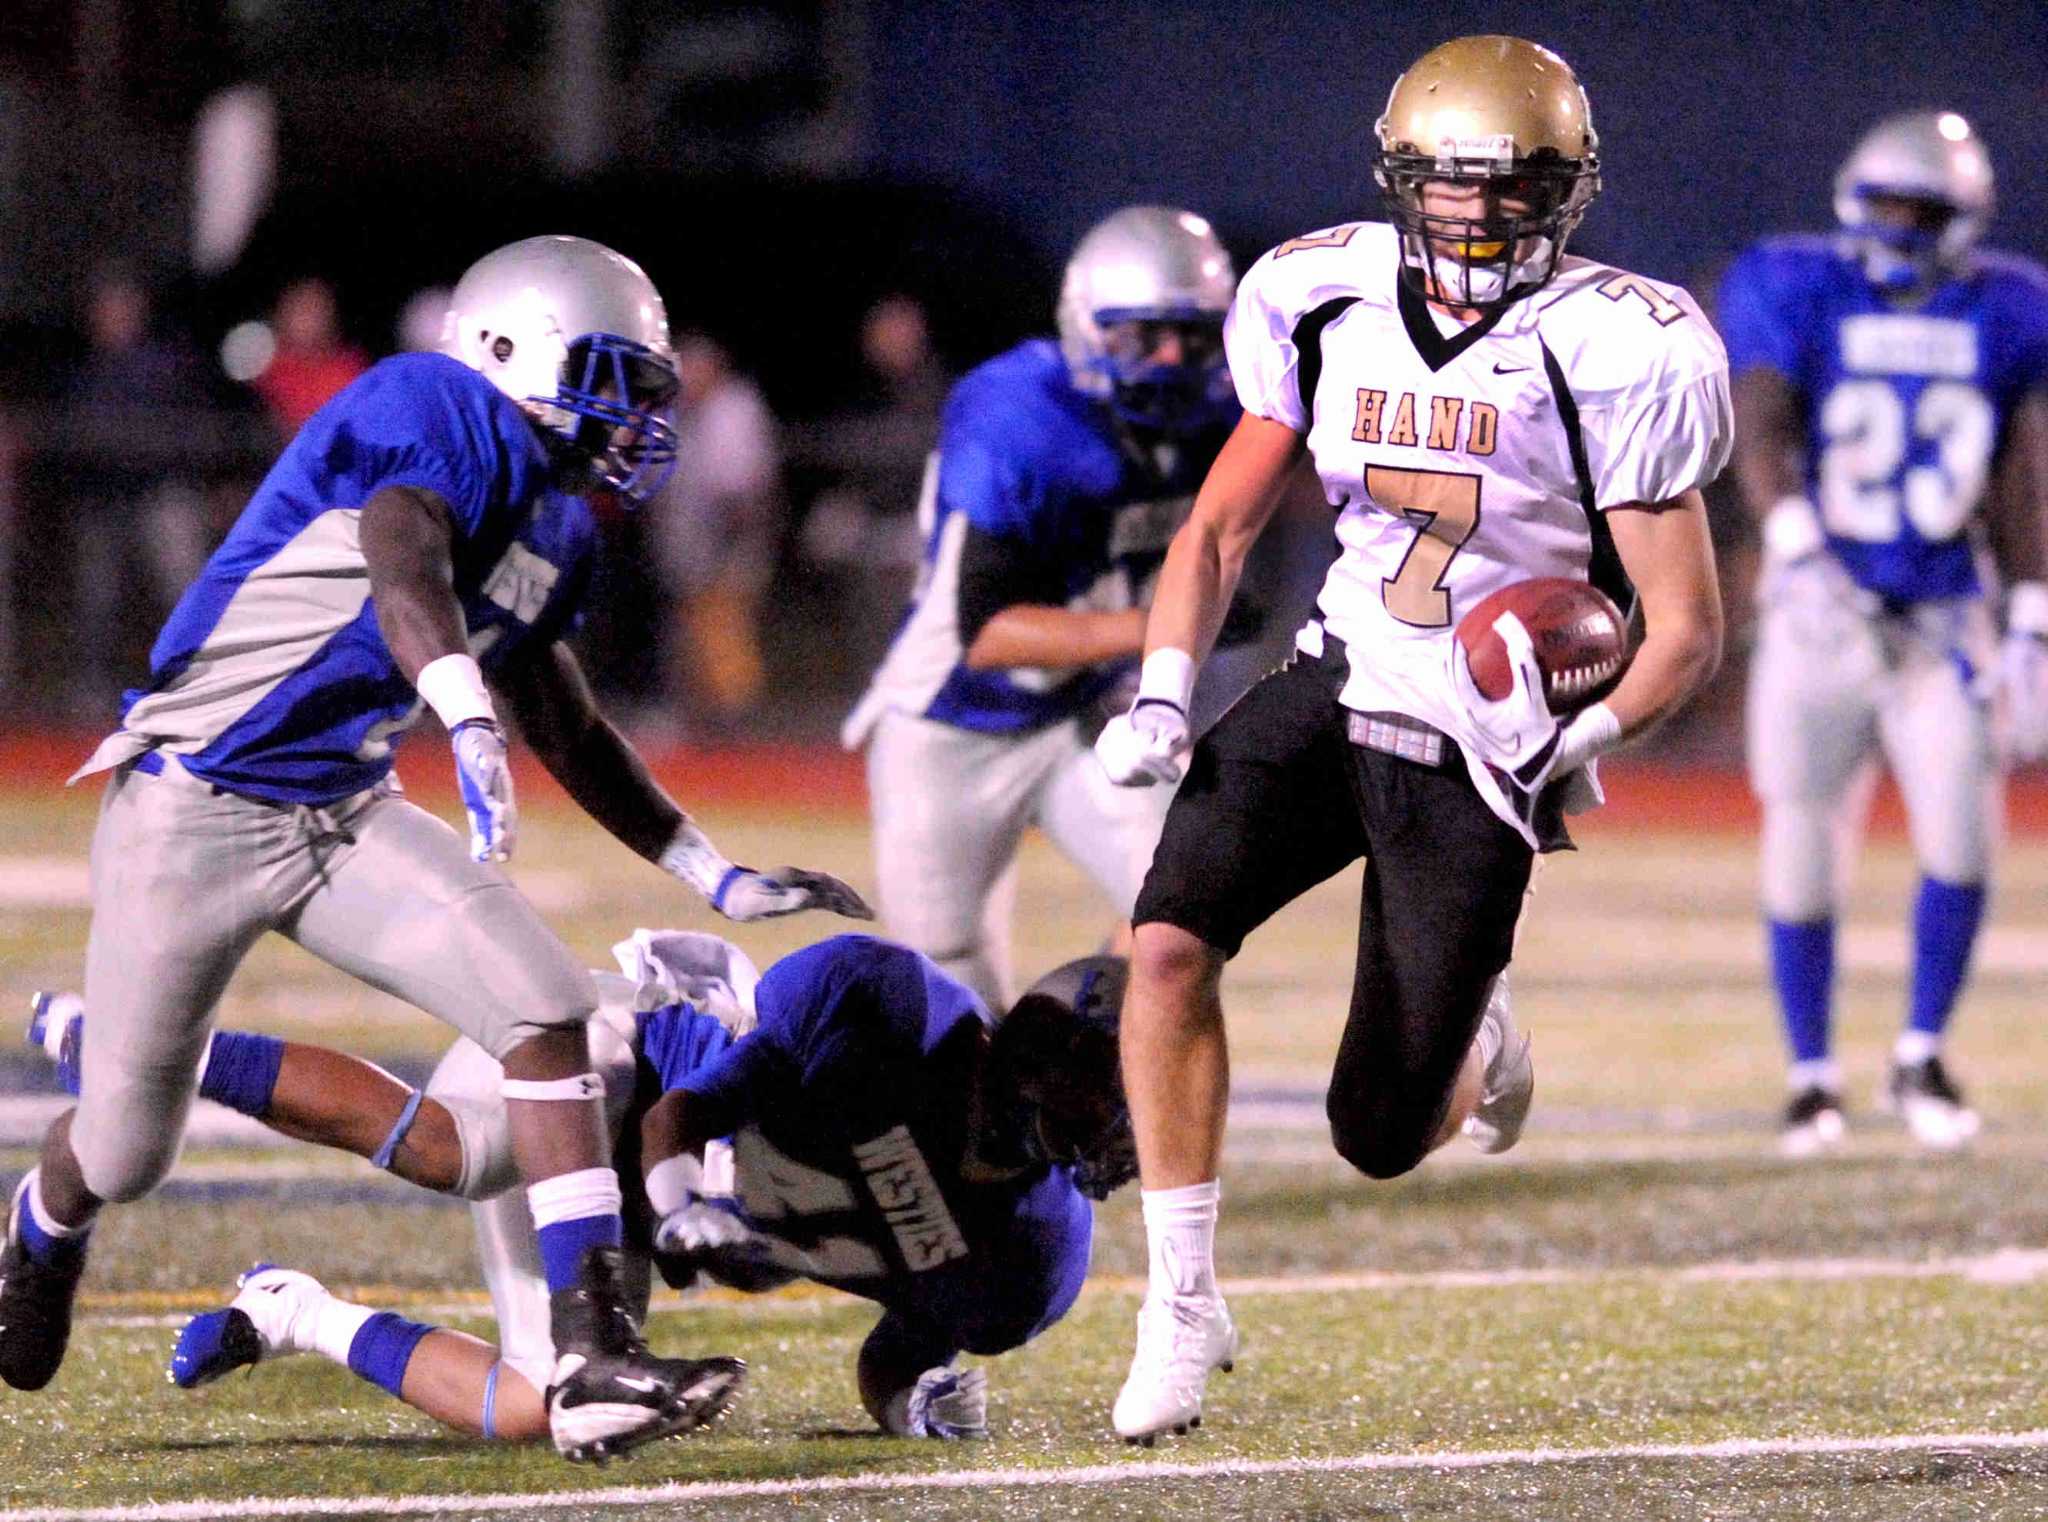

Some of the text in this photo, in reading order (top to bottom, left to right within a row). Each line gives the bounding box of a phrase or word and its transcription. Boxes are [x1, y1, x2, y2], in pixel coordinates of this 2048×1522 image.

[1596, 272, 1688, 327] 7
[1351, 388, 1499, 456] HAND
[1819, 379, 1993, 543] 23
[1364, 463, 1482, 629] 7
